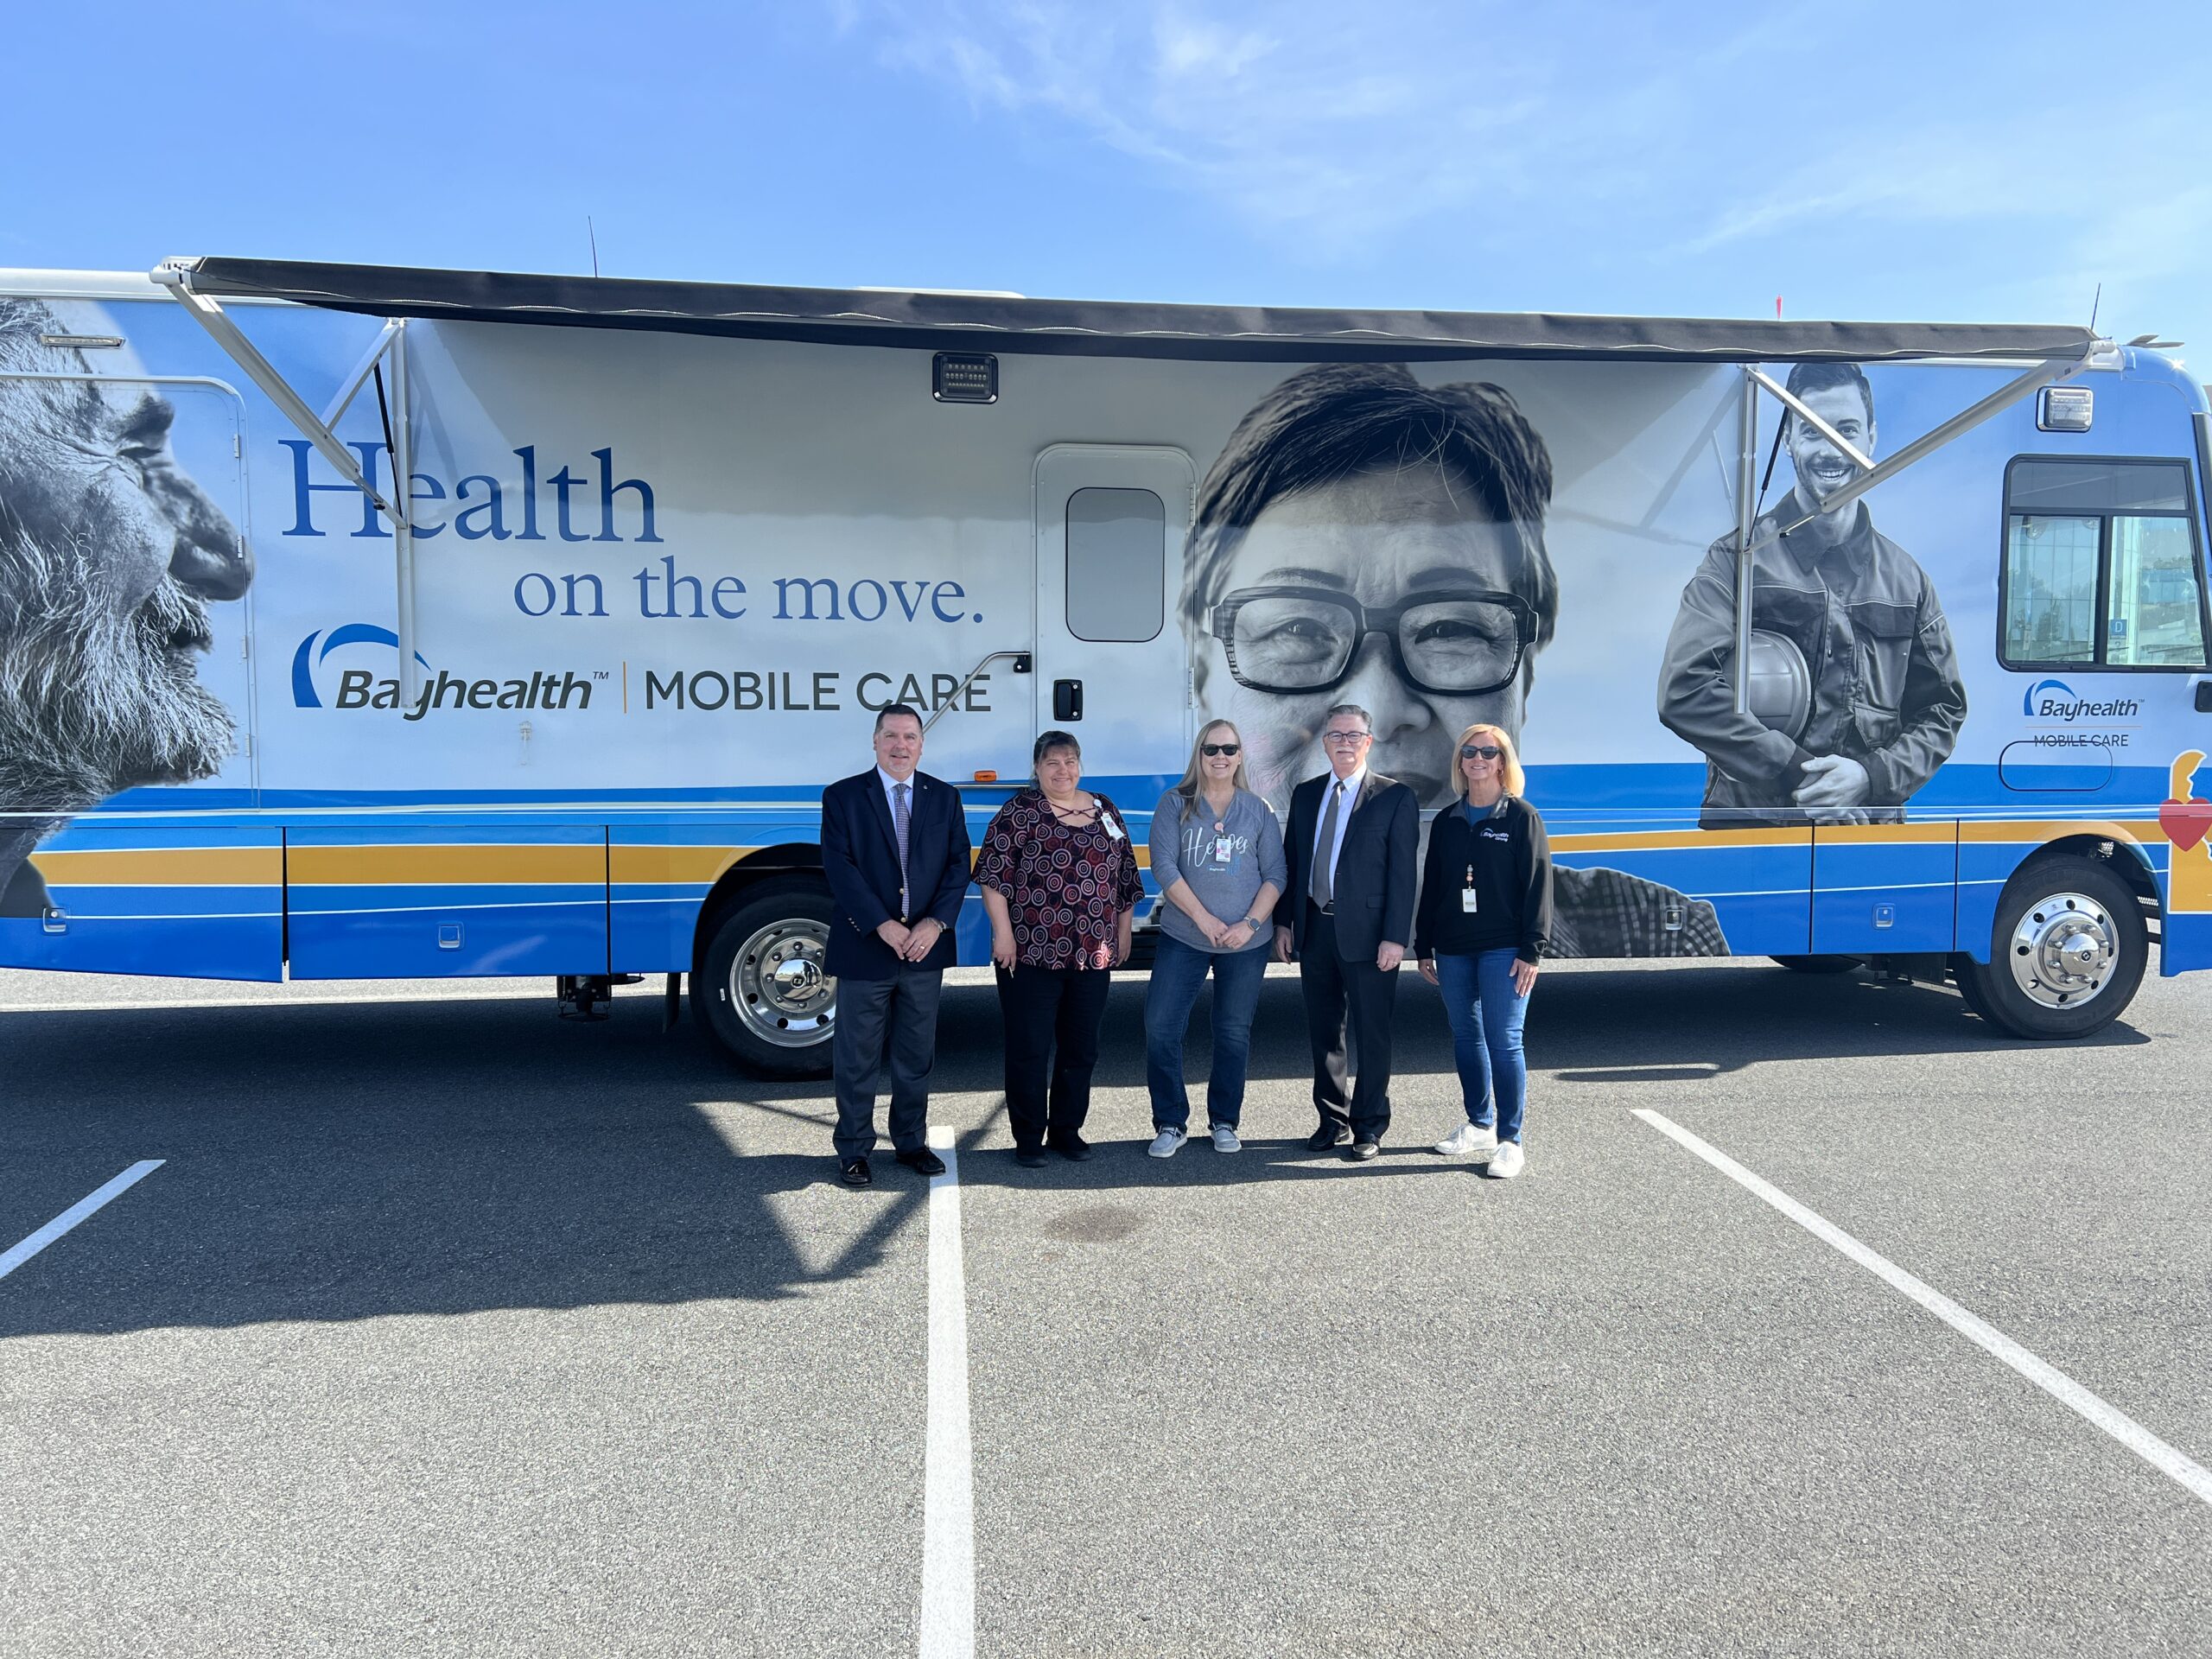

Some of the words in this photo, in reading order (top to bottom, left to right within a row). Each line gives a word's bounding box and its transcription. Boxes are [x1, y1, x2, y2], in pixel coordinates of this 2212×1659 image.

[278, 440, 664, 543] Health
[514, 574, 609, 617] on
[632, 556, 747, 620] the
[772, 579, 983, 623] move.
[336, 671, 593, 721] Bayhealth
[645, 671, 841, 711] MOBILE
[856, 672, 991, 712] CARE
[2039, 699, 2139, 721] Bayhealth
[2034, 734, 2088, 747] MOBILE
[2091, 734, 2129, 747] CARE
[1182, 827, 1249, 867] Heoes
